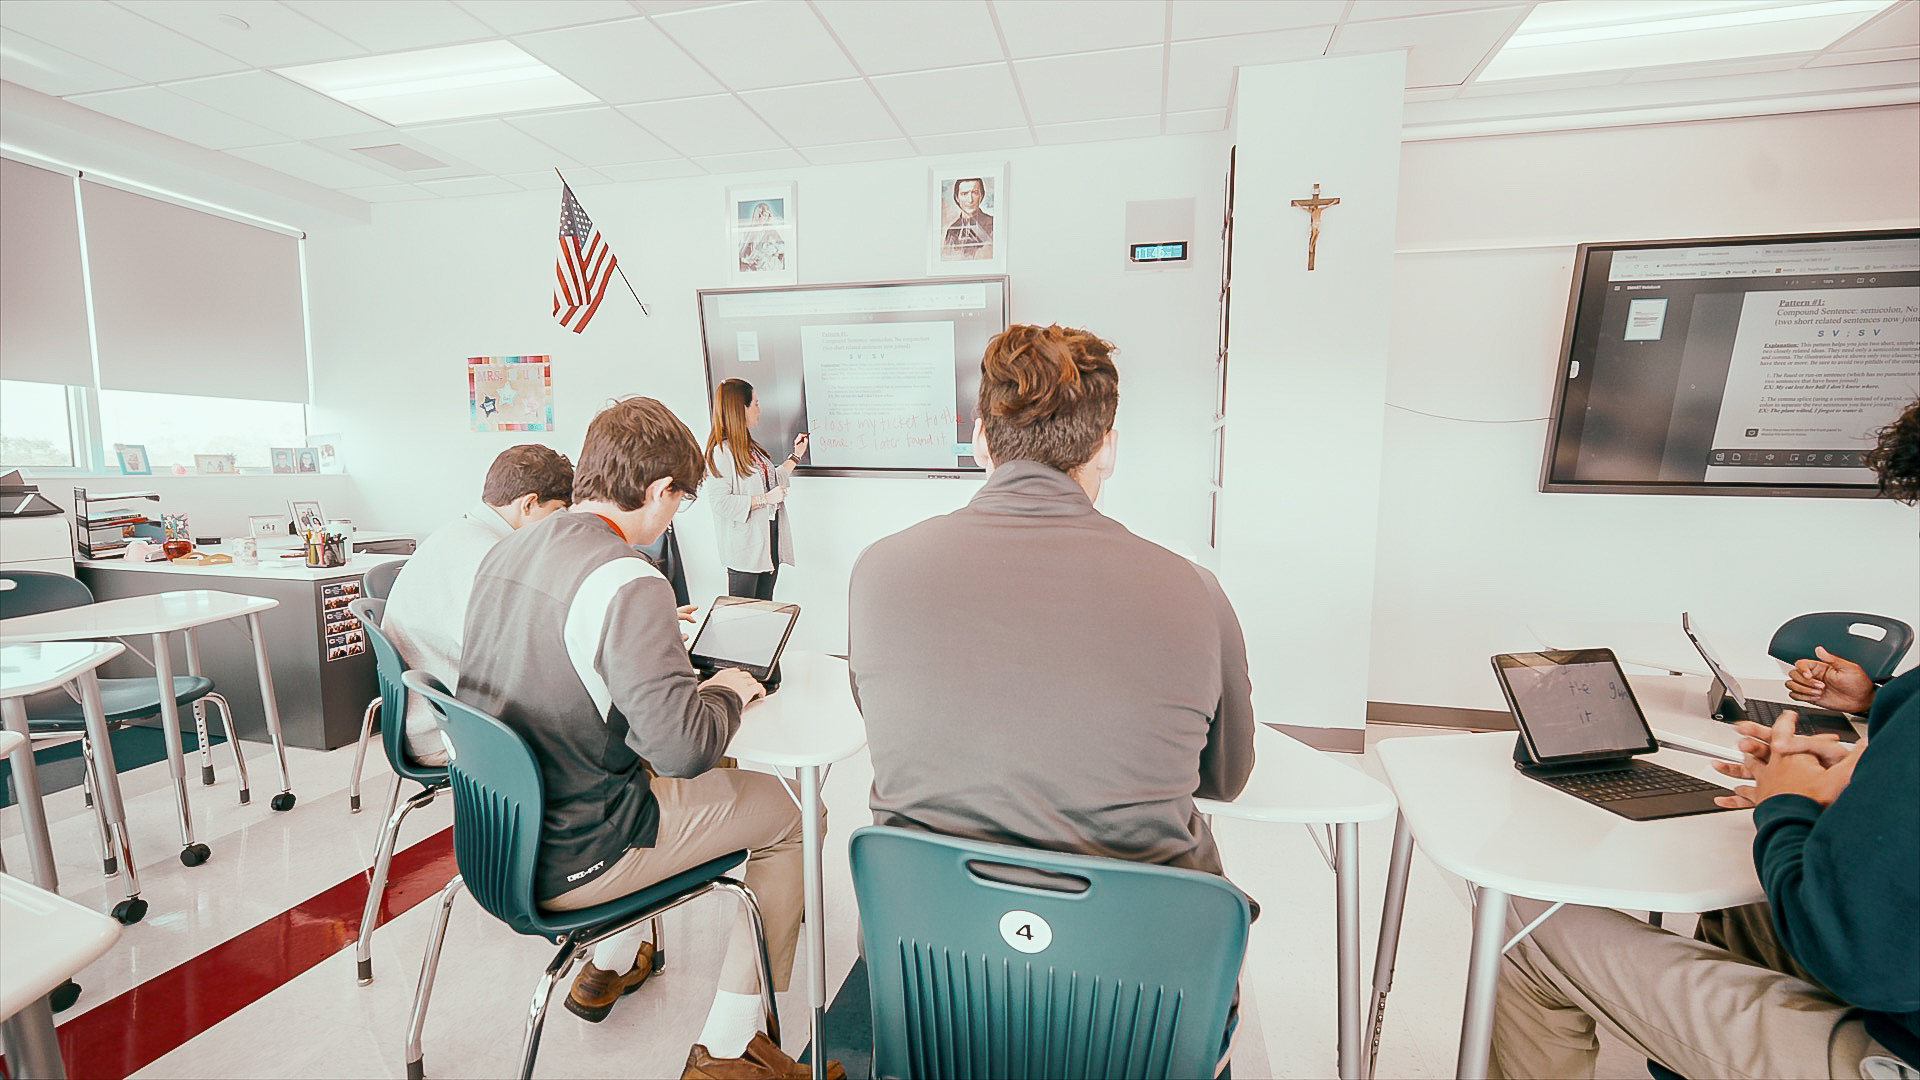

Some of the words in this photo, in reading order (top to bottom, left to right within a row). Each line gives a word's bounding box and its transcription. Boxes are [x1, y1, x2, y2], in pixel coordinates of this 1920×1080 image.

[1779, 299, 1810, 307] Pattern
[1812, 298, 1826, 306] #1:
[1777, 308, 1820, 317] Compound
[1820, 307, 1858, 315] Sentence:
[1860, 305, 1904, 314] semicolon,
[1905, 305, 1919, 313] No
[1775, 318, 1793, 326] (two
[1794, 317, 1814, 325] short
[1815, 317, 1842, 325] related
[1842, 316, 1881, 324] sentences
[1817, 329, 1825, 338] S
[1832, 329, 1840, 337] V
[1857, 329, 1866, 337] S
[1873, 328, 1882, 336] V
[824, 415, 851, 433] lost
[857, 417, 876, 437] my
[880, 415, 920, 433] ticket
[926, 410, 938, 429] to
[874, 437, 900, 451] later
[907, 431, 933, 448] found
[1016, 924, 1034, 940] 4
